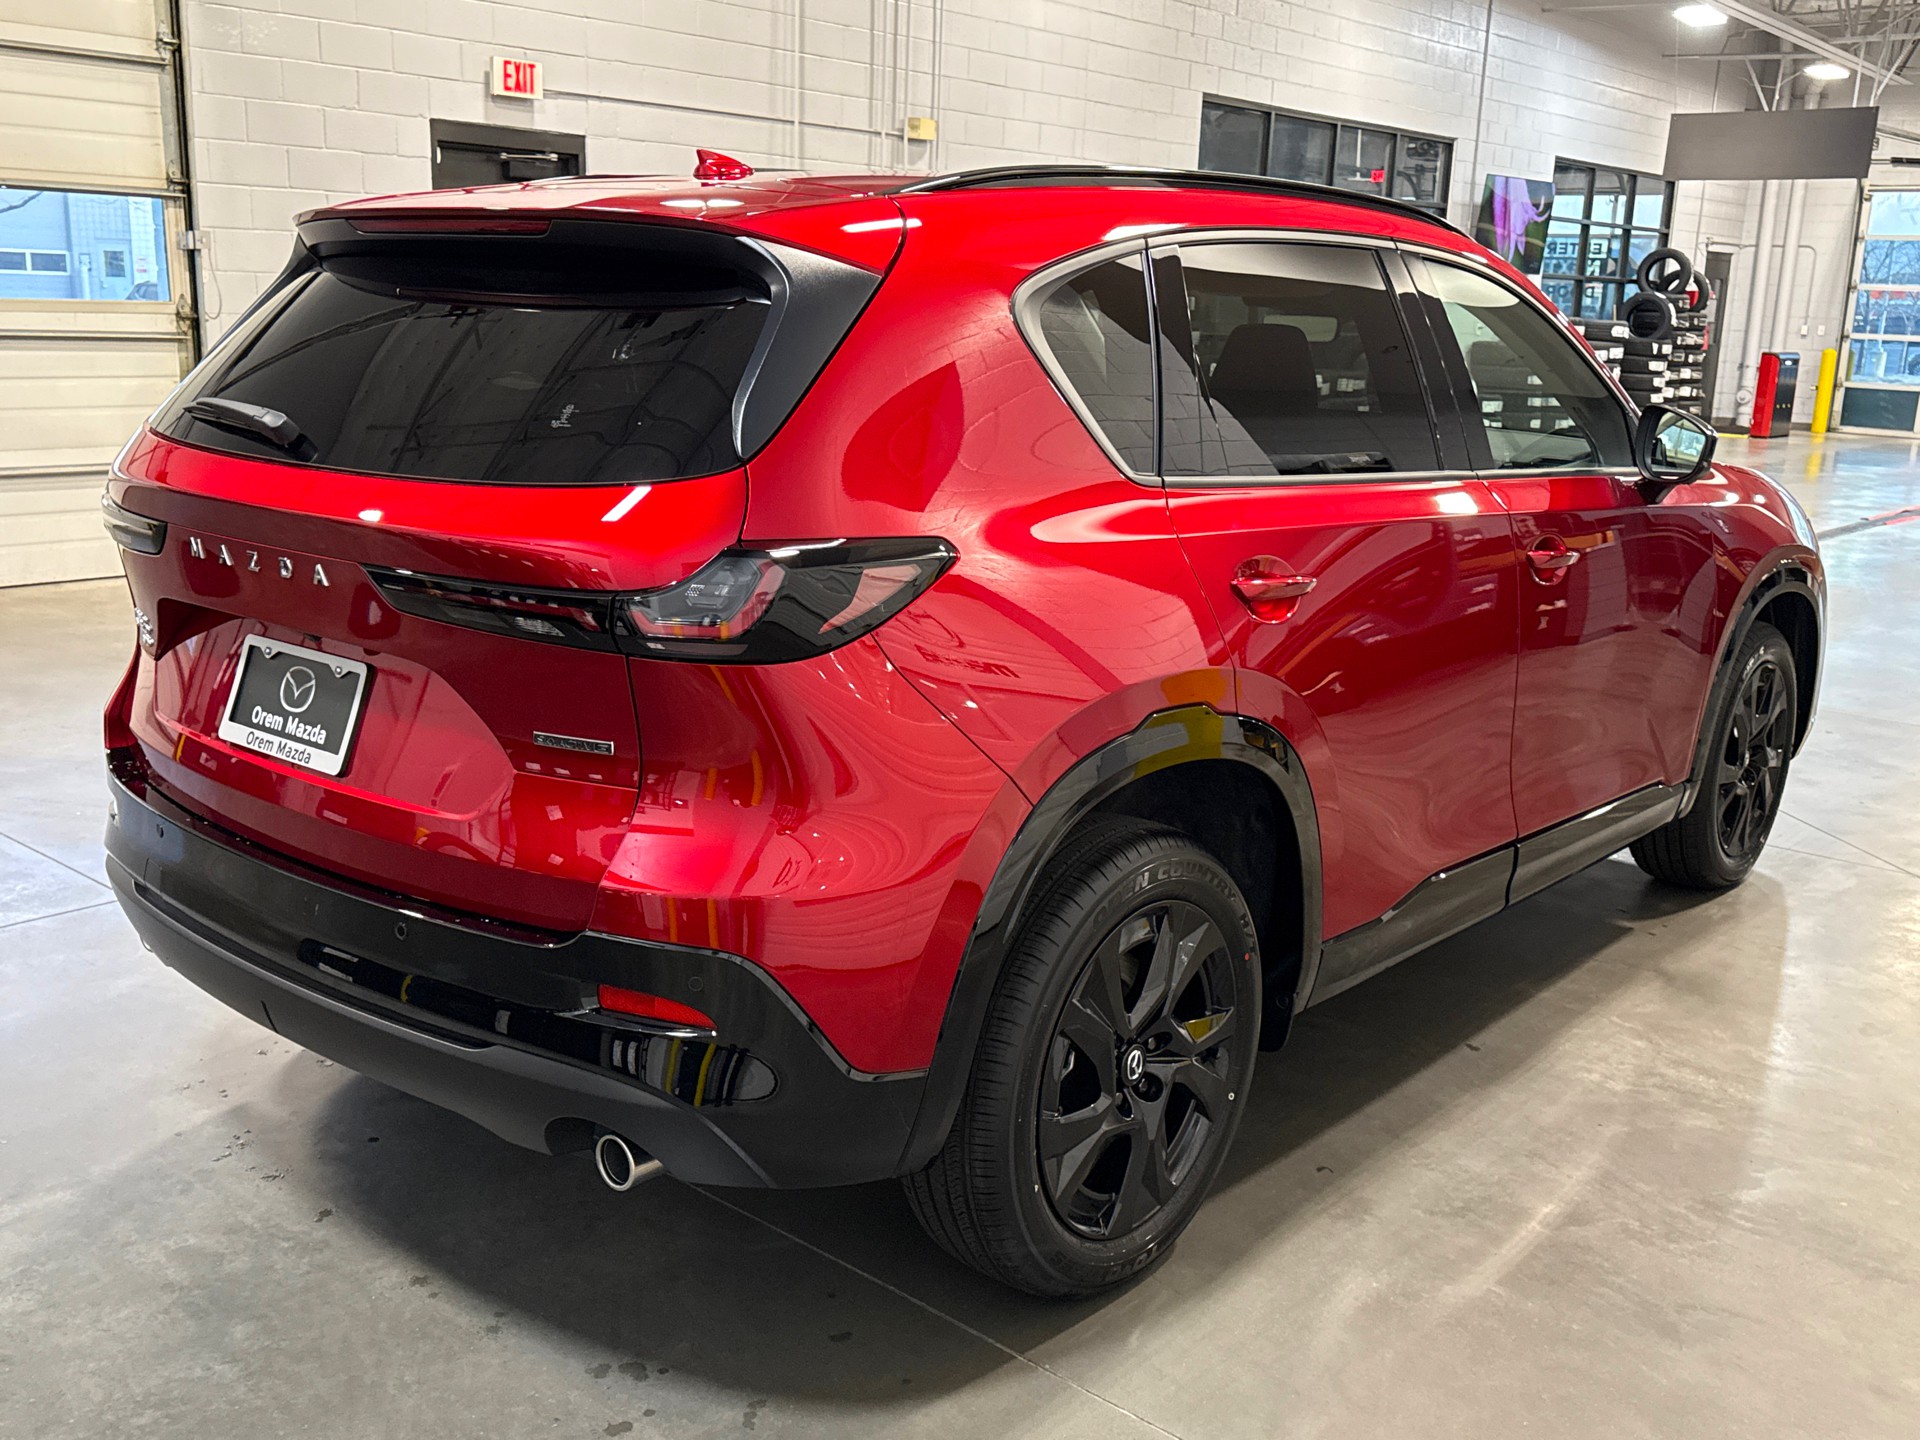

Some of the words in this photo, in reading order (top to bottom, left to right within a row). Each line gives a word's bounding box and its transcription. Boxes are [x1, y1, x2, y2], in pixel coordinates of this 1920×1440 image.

[503, 60, 536, 95] EXIT
[189, 536, 330, 587] MAZDA
[251, 705, 284, 731] Orem
[285, 715, 327, 745] Mazda
[246, 731, 274, 752] Orem
[276, 740, 312, 764] Mazda
[1157, 860, 1237, 901] COUNTRY
